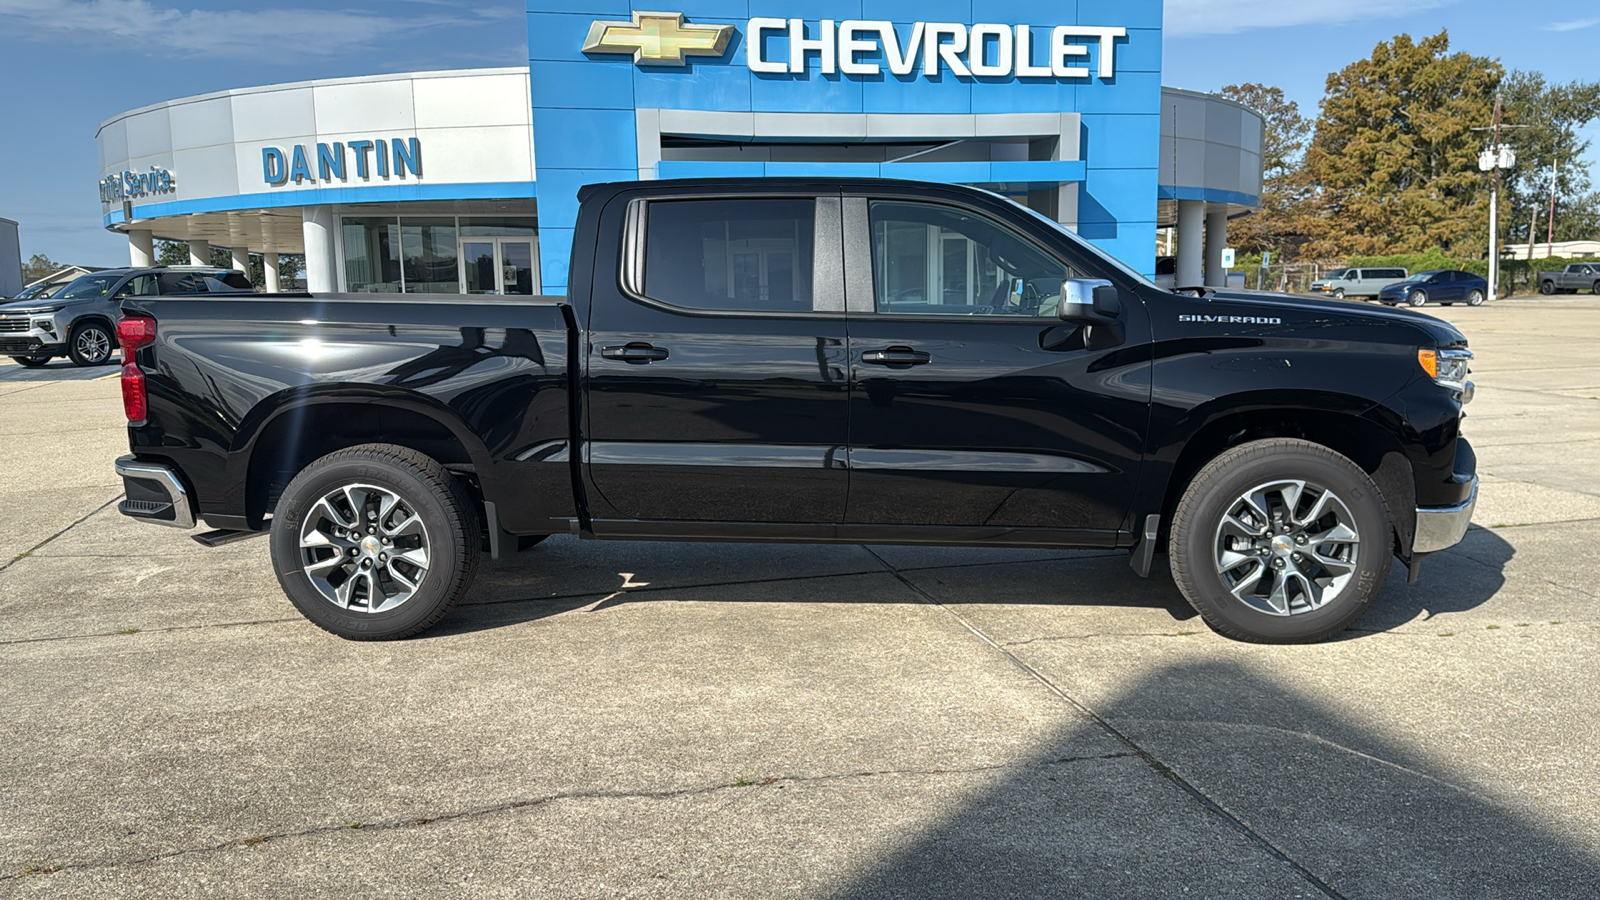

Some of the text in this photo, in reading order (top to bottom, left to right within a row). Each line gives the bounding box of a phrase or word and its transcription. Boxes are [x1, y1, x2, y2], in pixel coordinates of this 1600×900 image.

[747, 17, 1127, 79] CHEVROLET
[262, 137, 420, 184] DANTIN
[124, 165, 171, 196] Service
[1178, 314, 1282, 325] SILVERADO
